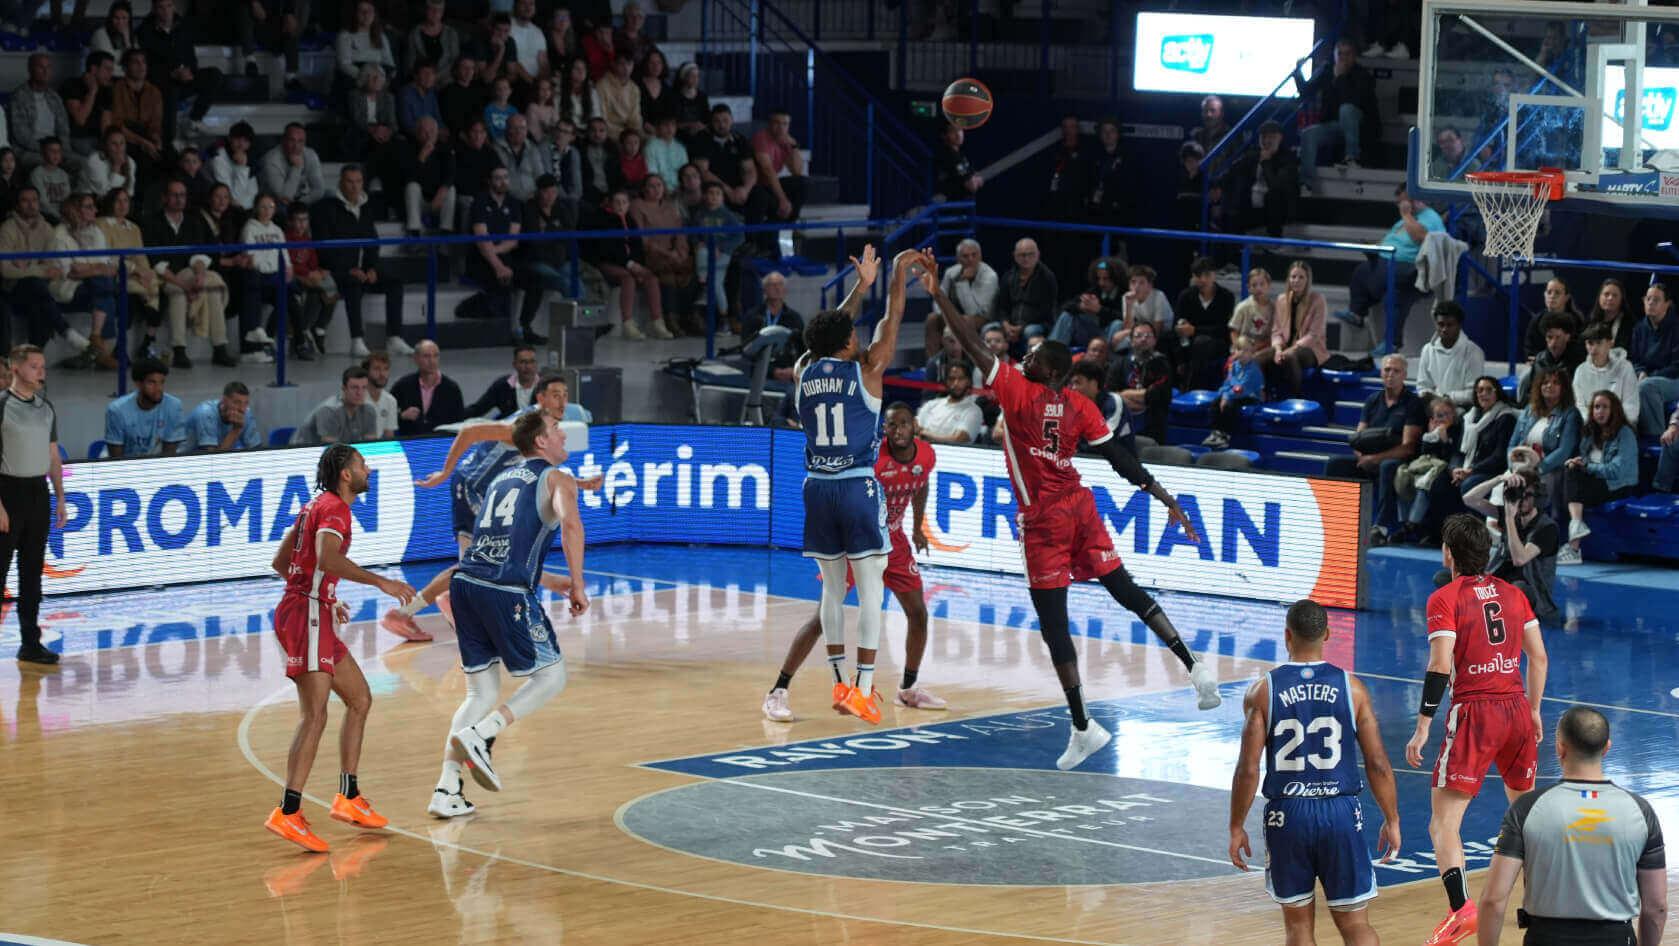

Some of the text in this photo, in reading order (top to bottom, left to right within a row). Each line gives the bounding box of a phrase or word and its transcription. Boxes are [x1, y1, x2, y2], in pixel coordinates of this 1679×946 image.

[802, 378, 858, 397] DURHAM II
[814, 403, 848, 446] 11
[1042, 419, 1060, 454] 5
[562, 440, 770, 509] térim
[480, 487, 520, 528] 14
[936, 471, 1281, 567] PRMAN
[1482, 600, 1507, 646] 6
[1278, 684, 1340, 708] MASTERS
[711, 729, 970, 769] RAYON
[1274, 715, 1343, 772] 23
[1267, 810, 1286, 828] 23
